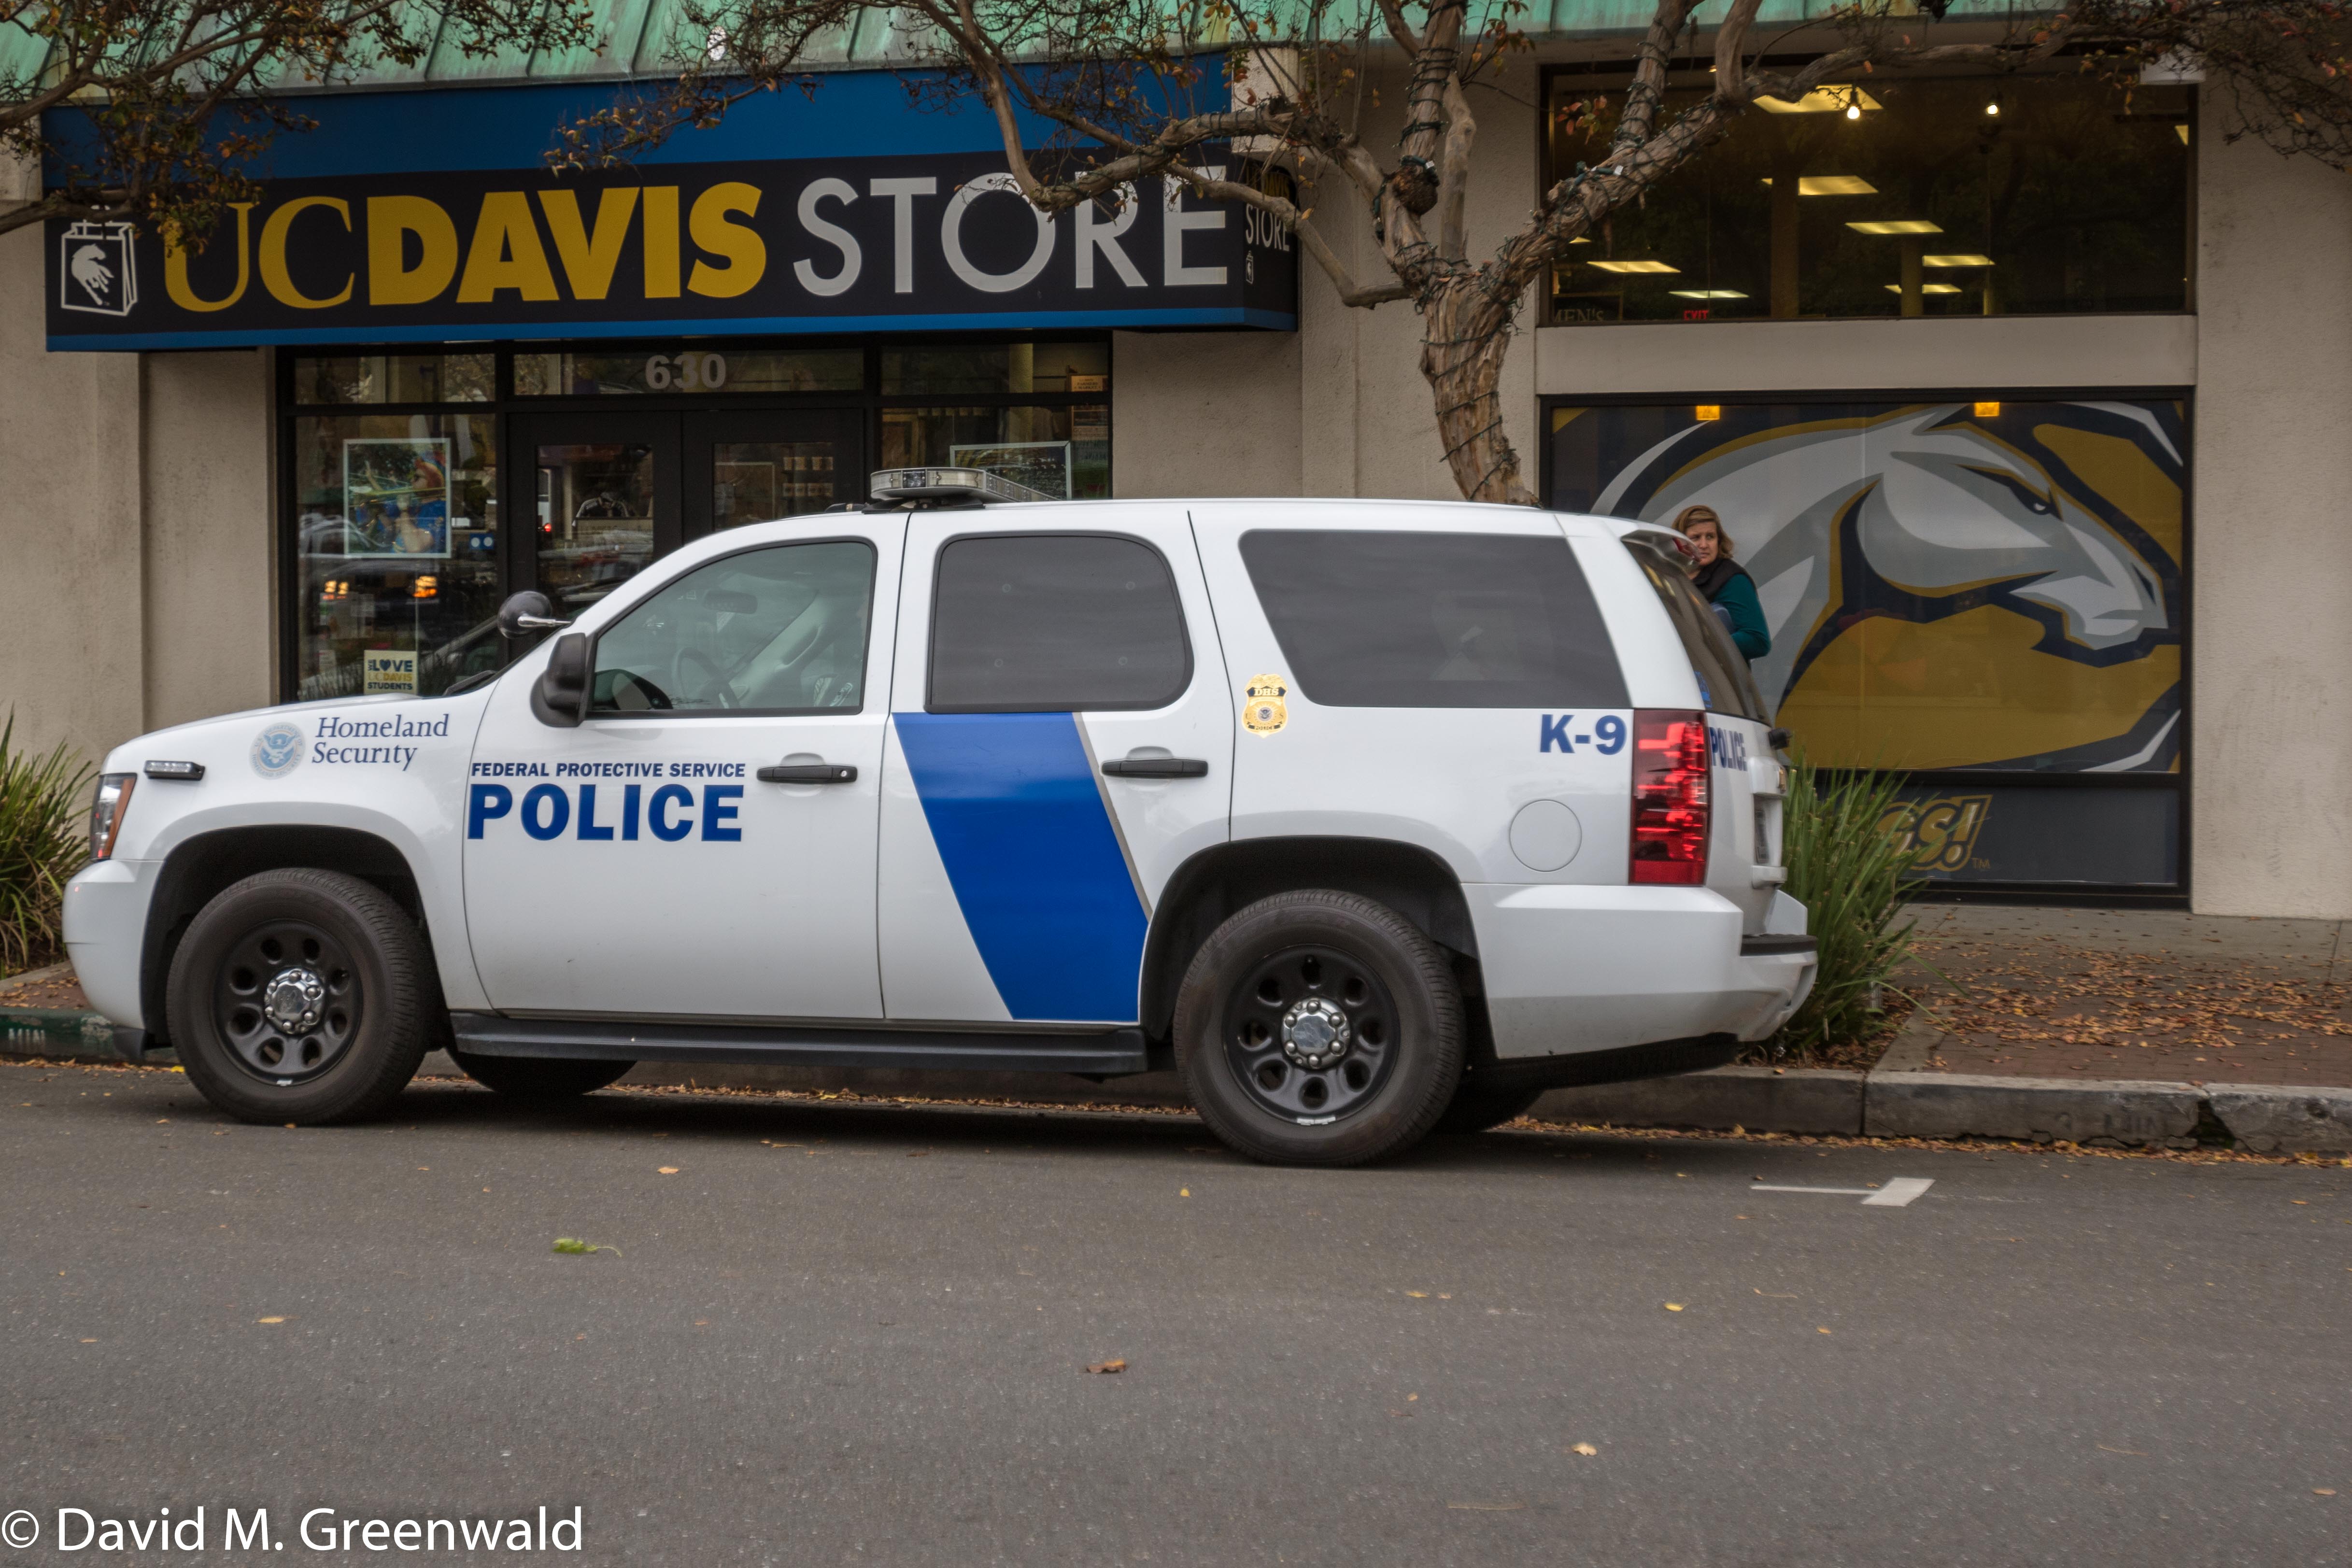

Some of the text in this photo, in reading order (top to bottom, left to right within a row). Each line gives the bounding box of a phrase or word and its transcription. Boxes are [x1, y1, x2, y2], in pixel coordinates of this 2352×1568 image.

[793, 165, 1228, 297] STORE
[1684, 309, 1709, 321] EXIT
[645, 353, 726, 389] 630
[1254, 688, 1279, 696] DHS
[314, 713, 449, 738] Homeland
[1539, 714, 1627, 755] K-9
[312, 742, 417, 771] Security
[1708, 727, 1748, 772] POLICE
[471, 763, 746, 777] FEDERAL PROTECTIVE SERVICE
[467, 783, 744, 842] POLICE
